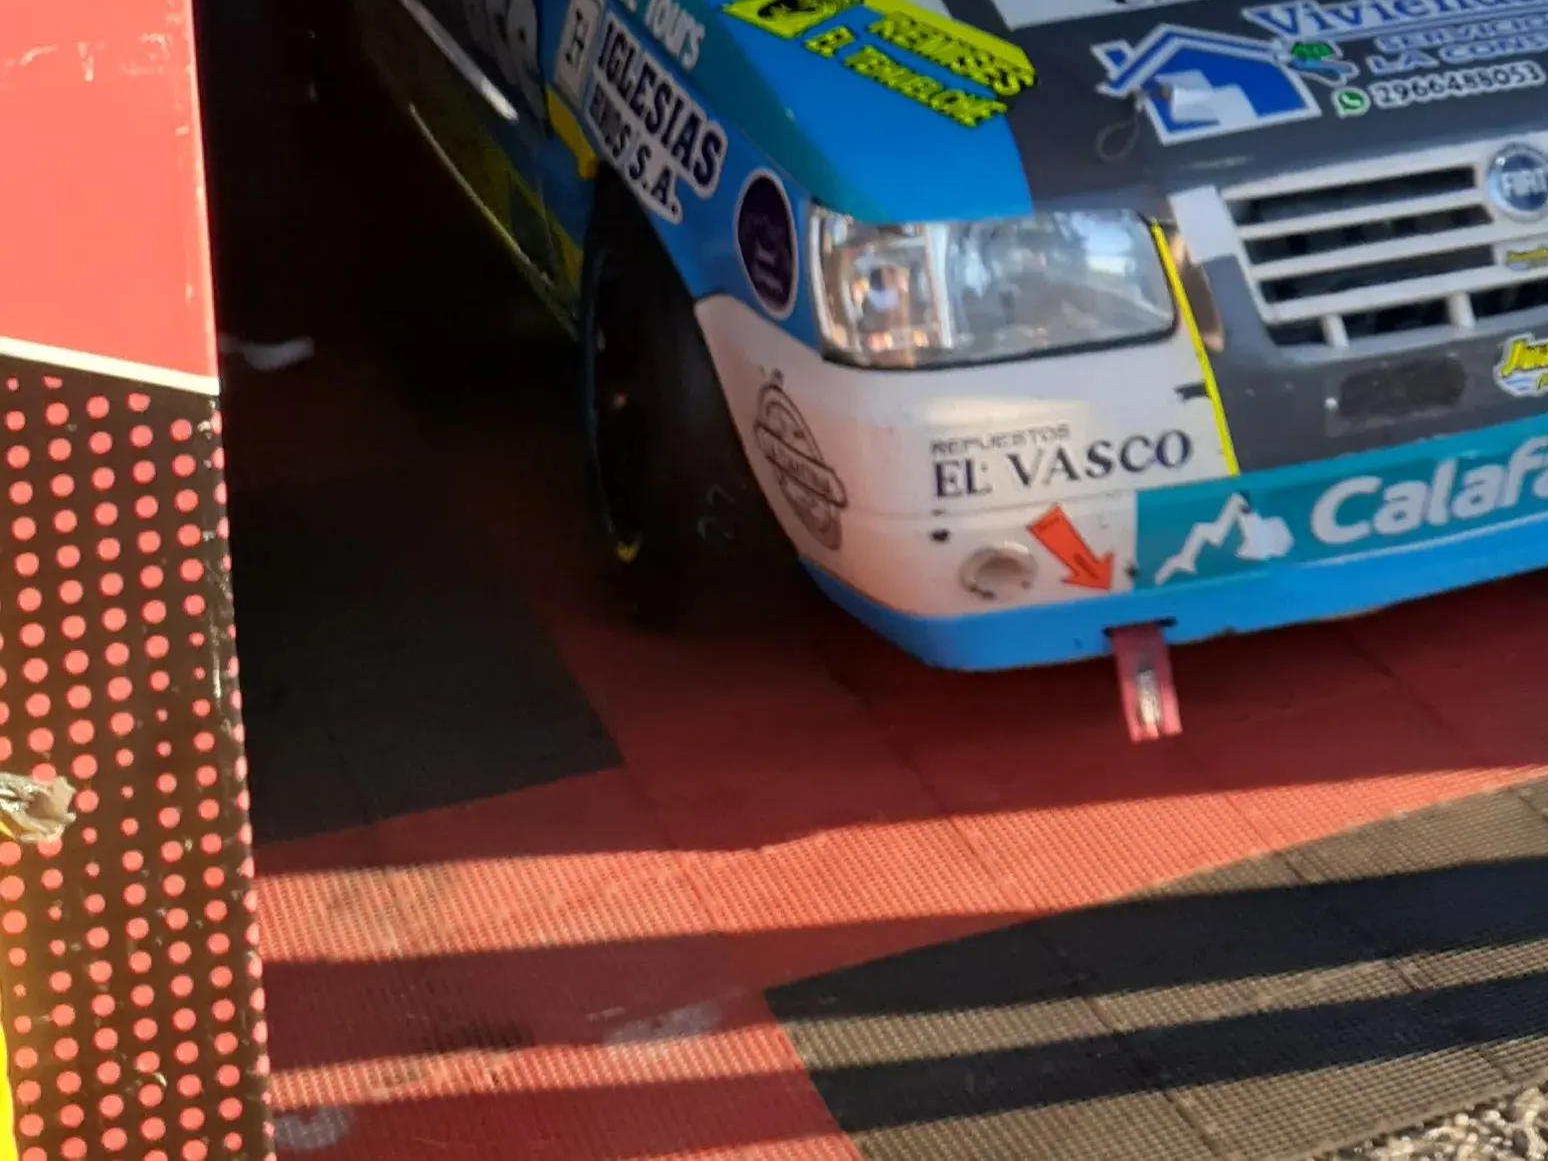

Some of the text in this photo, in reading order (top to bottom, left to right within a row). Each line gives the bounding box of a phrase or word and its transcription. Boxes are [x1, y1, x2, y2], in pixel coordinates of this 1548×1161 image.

[1369, 47, 1438, 75] LA
[597, 20, 722, 186] IGLESIAS
[931, 422, 1071, 456] REPUESTOS
[932, 429, 1193, 499] EL VASCO
